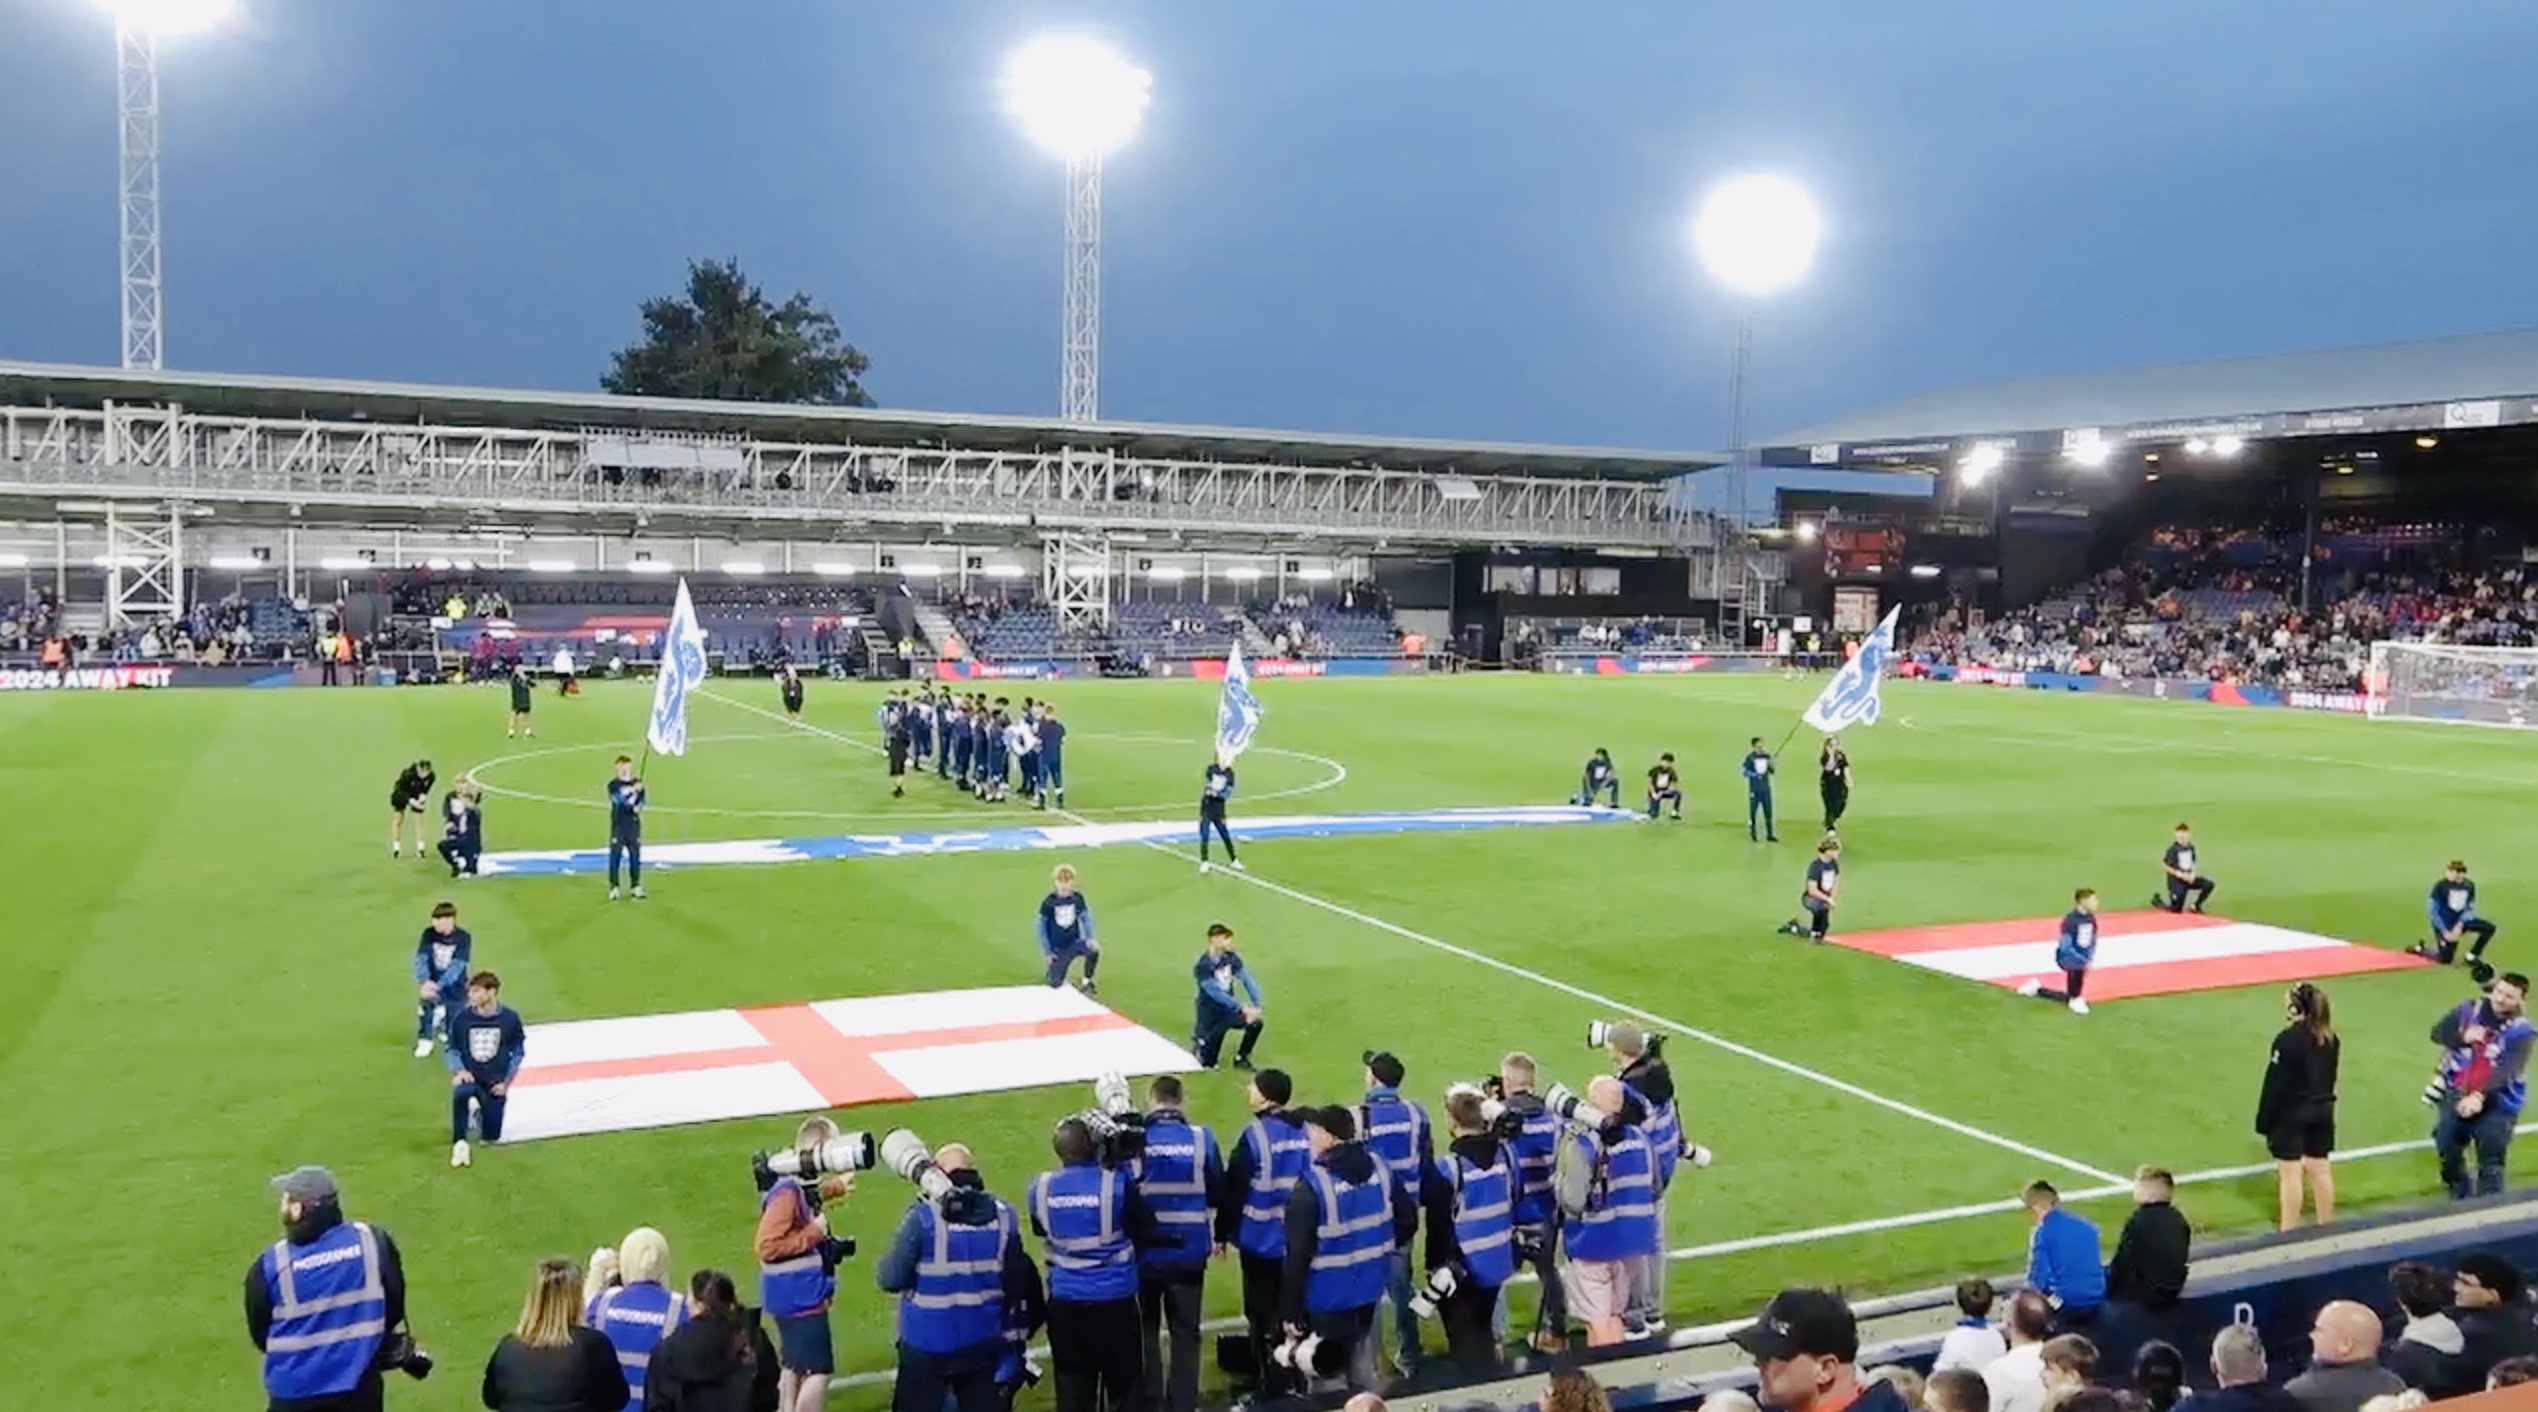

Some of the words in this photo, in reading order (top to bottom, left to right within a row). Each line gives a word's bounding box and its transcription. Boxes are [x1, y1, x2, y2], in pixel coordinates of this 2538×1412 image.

[0, 668, 62, 688] 2024
[64, 668, 131, 690] AWAY
[134, 668, 173, 688] KIT
